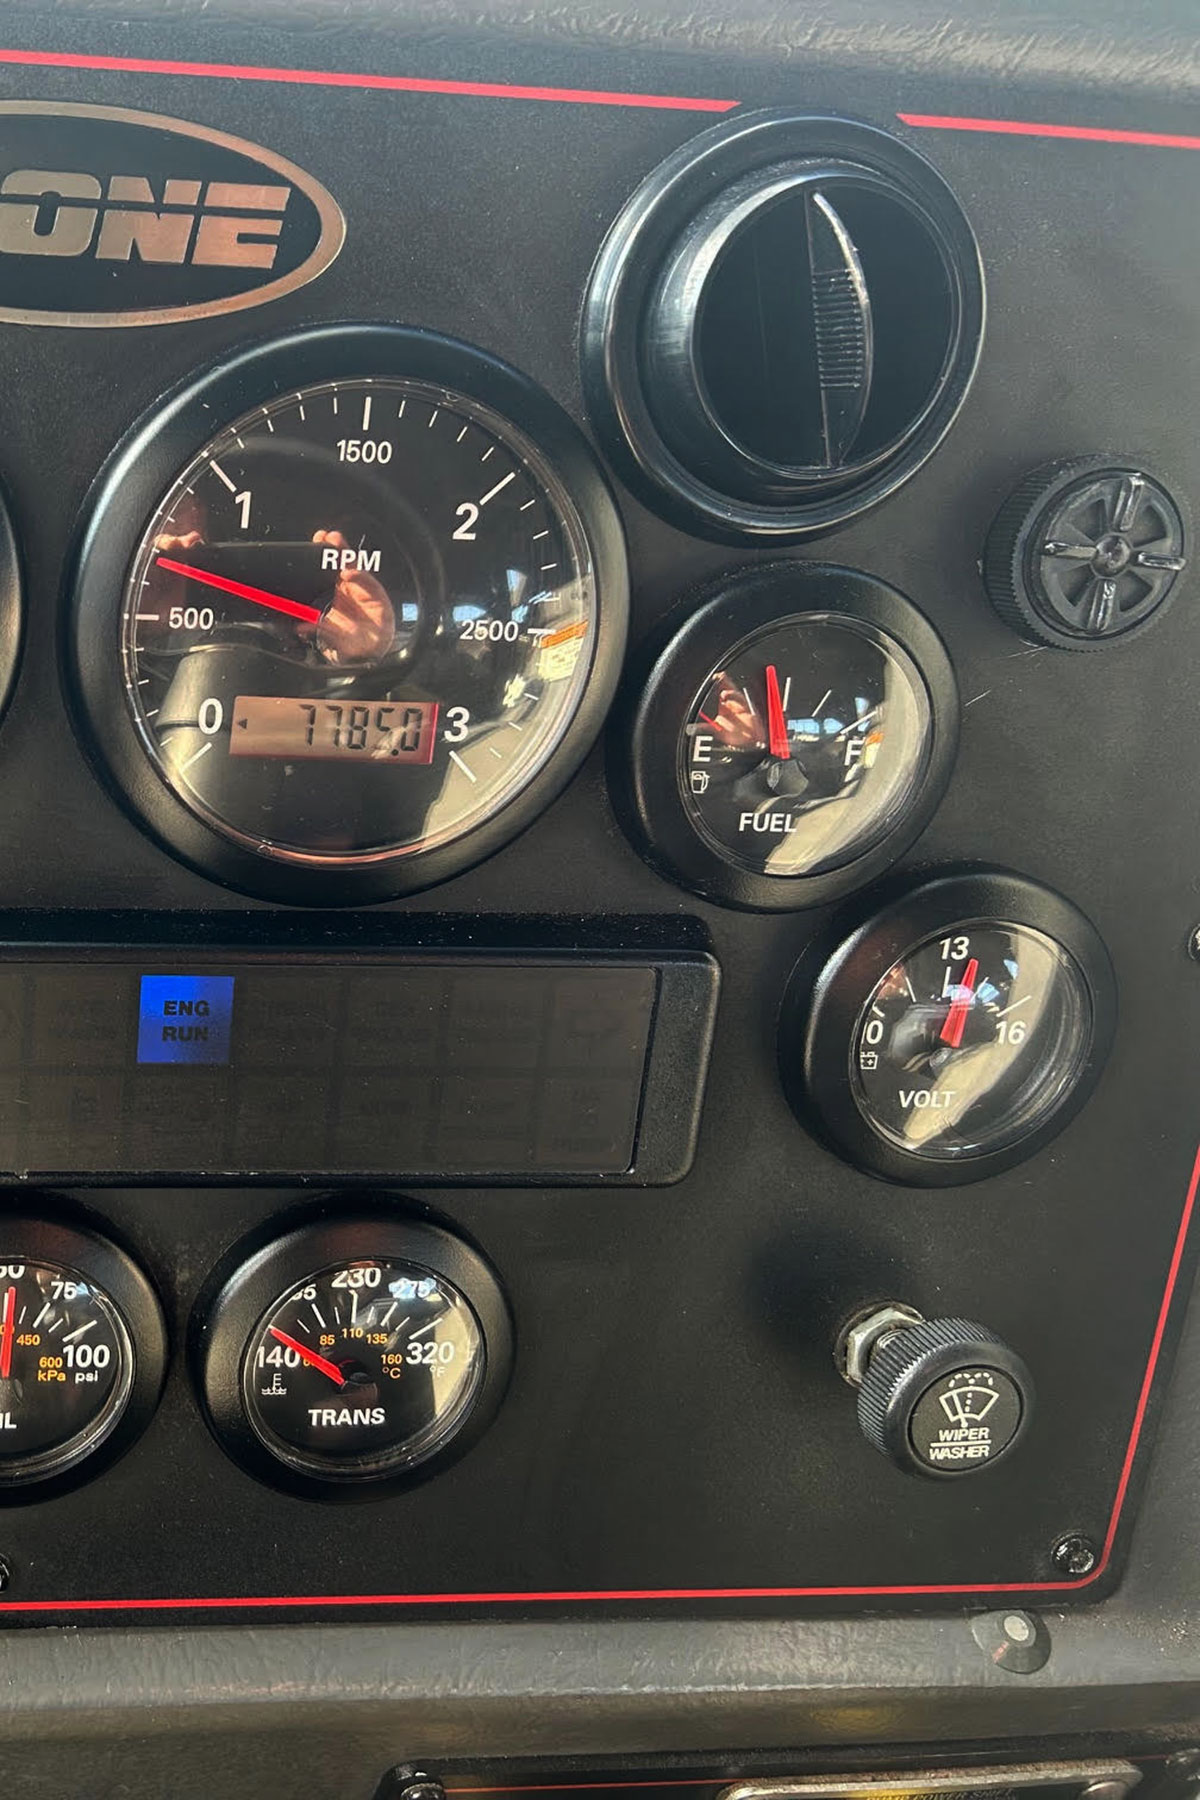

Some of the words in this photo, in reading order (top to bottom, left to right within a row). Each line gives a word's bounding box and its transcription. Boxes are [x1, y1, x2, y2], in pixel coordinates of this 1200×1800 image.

[336, 440, 392, 465] 1500
[235, 491, 254, 529] 1
[453, 502, 479, 541] 2
[321, 549, 381, 572] RPM
[168, 608, 214, 630] 500
[459, 620, 519, 642] 2500
[198, 697, 223, 735] 0
[444, 706, 470, 742] 3
[692, 735, 713, 762] E
[844, 739, 865, 766] F
[738, 812, 797, 833] FUEL
[939, 936, 970, 960] 13
[164, 1000, 210, 1017] ENG
[162, 1026, 210, 1043] RUN
[995, 1021, 1026, 1045] 16
[898, 1090, 956, 1108] VOLT
[331, 1267, 381, 1288] 230
[50, 1281, 77, 1300] 75
[16, 1334, 41, 1345] 450
[320, 1334, 335, 1345] 85
[341, 1328, 363, 1339] 110
[366, 1334, 388, 1345] 135
[39, 1357, 63, 1368] 600
[63, 1344, 110, 1368] 100
[258, 1346, 300, 1368] 140
[380, 1353, 402, 1365] 160
[405, 1341, 454, 1364] 320
[38, 1370, 66, 1382] kPa
[75, 1371, 98, 1383] psi
[308, 1408, 386, 1426] TRANS
[939, 1427, 990, 1442] WIPER
[929, 1445, 990, 1460] WASHER
